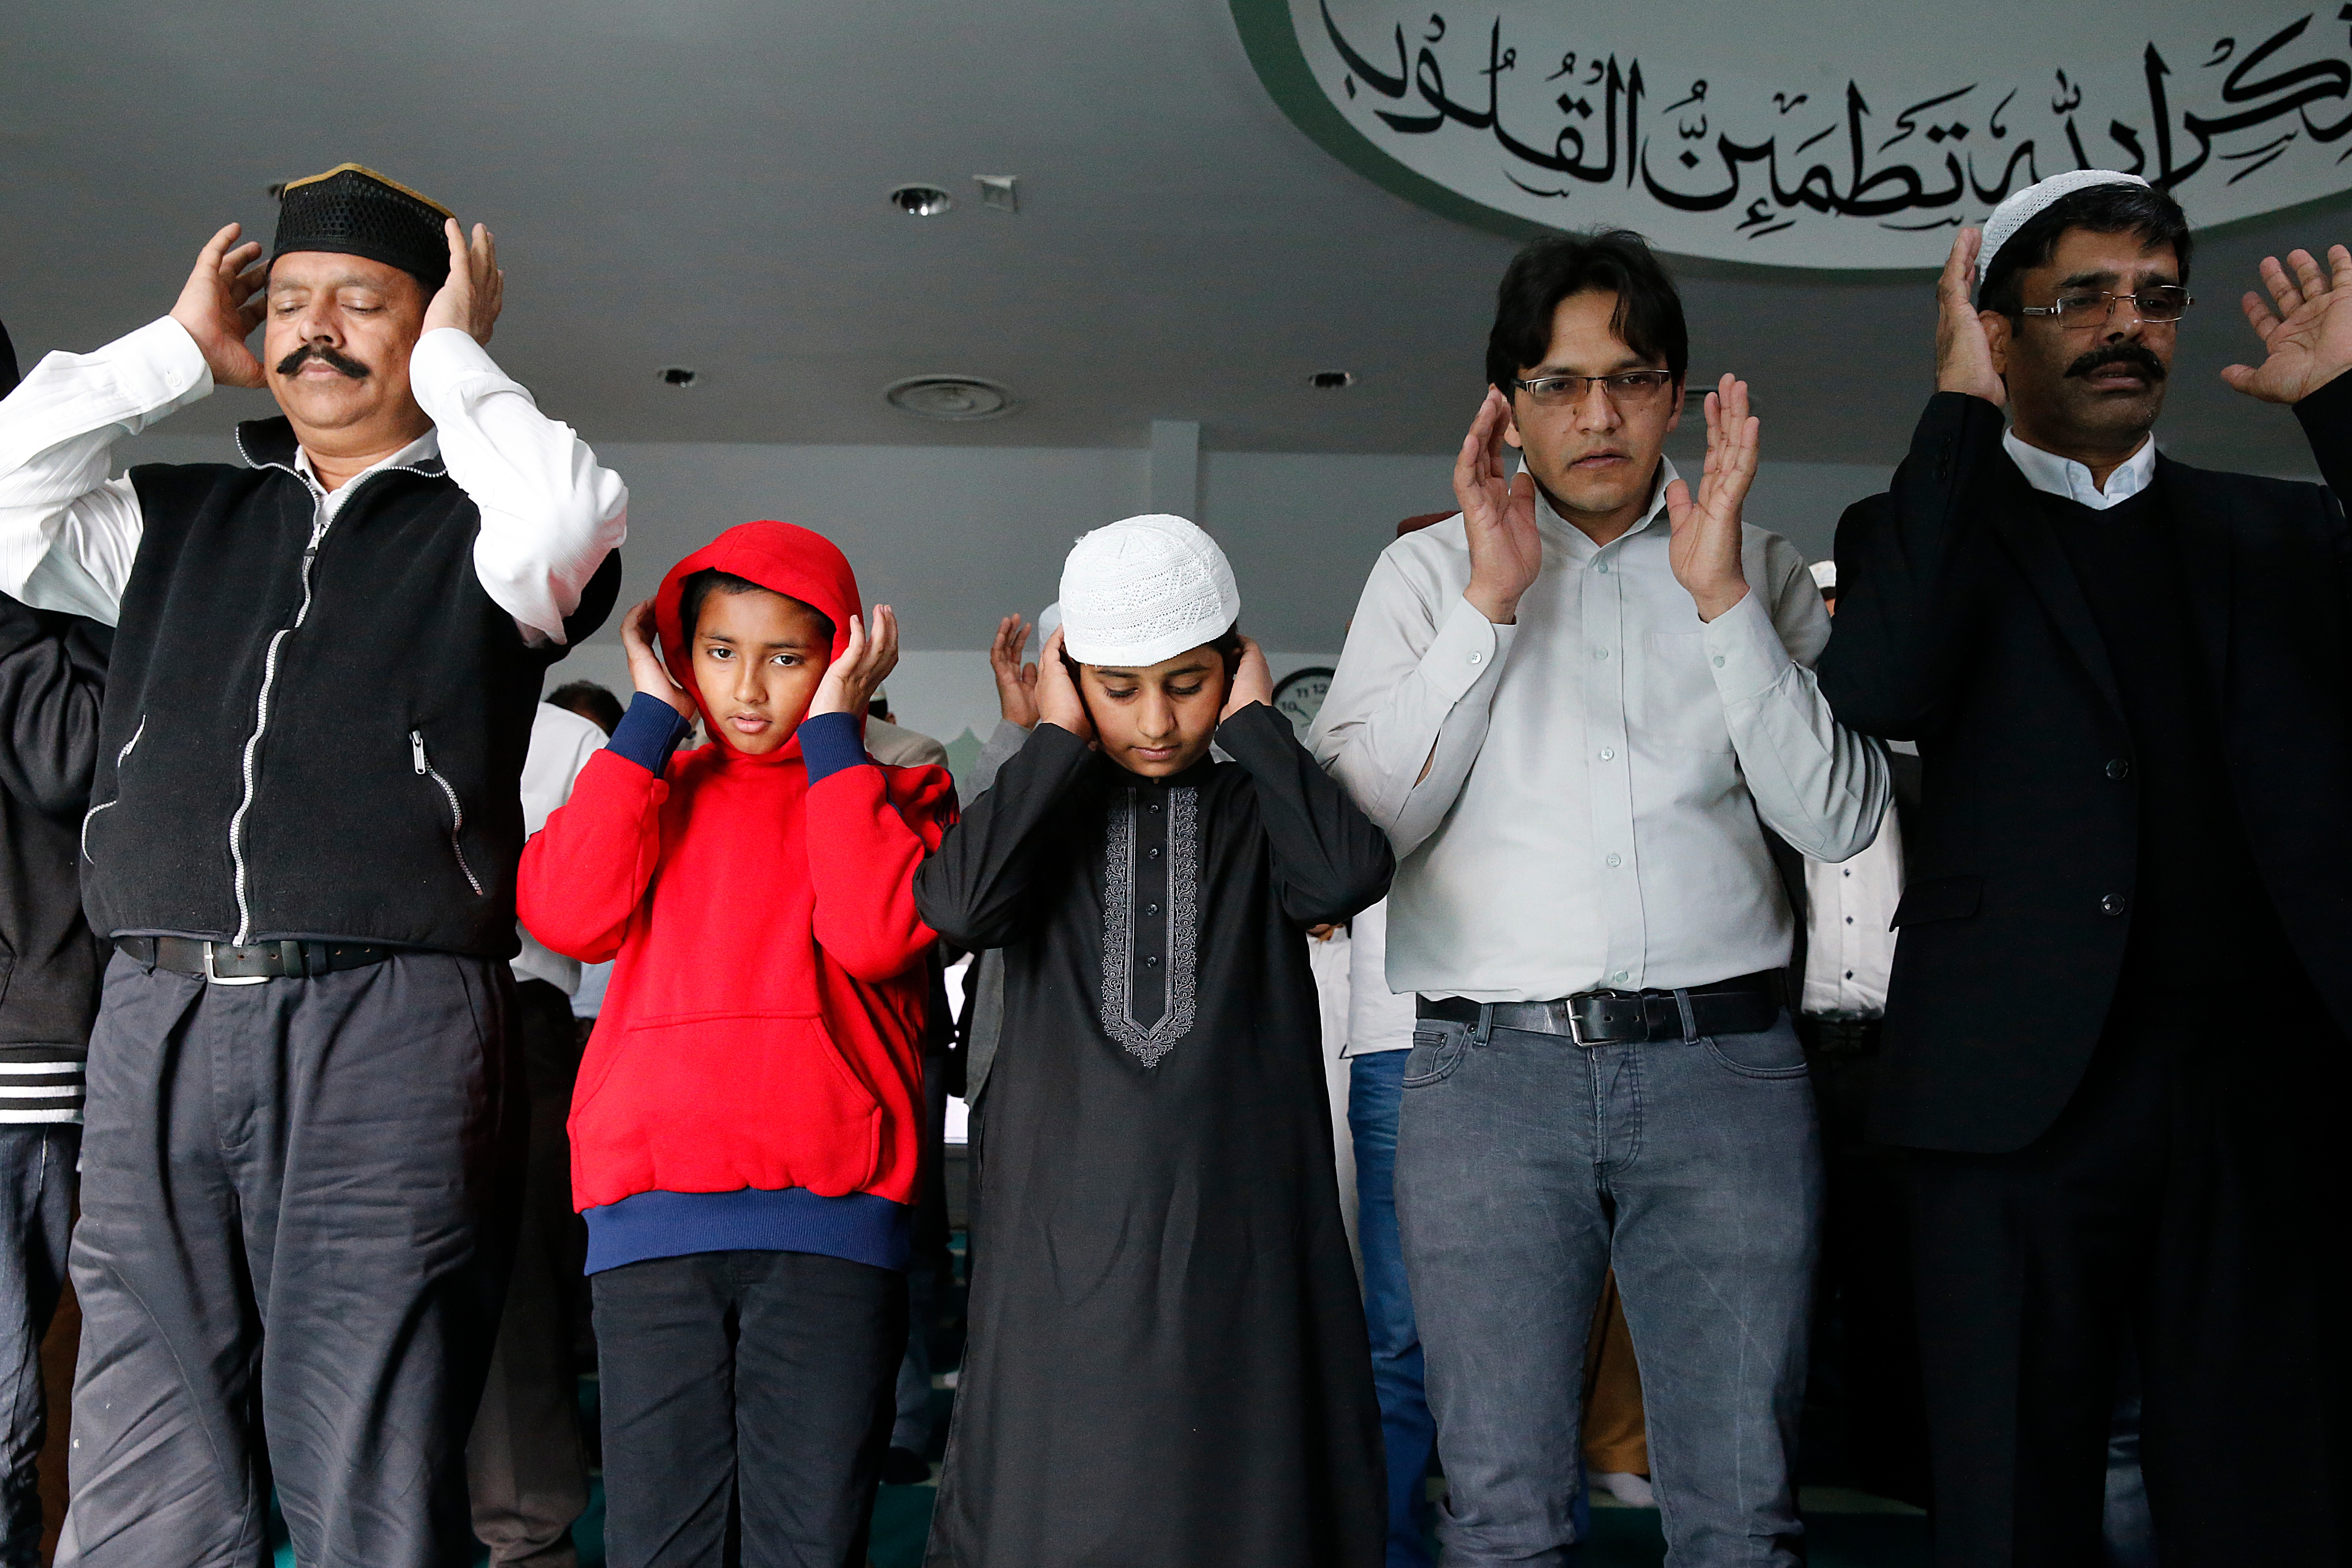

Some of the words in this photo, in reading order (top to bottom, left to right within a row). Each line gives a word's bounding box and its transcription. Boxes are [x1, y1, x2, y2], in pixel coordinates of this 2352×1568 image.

[1296, 688, 1309, 698] 11
[1313, 683, 1328, 694] 12
[1282, 701, 1298, 710] 10
